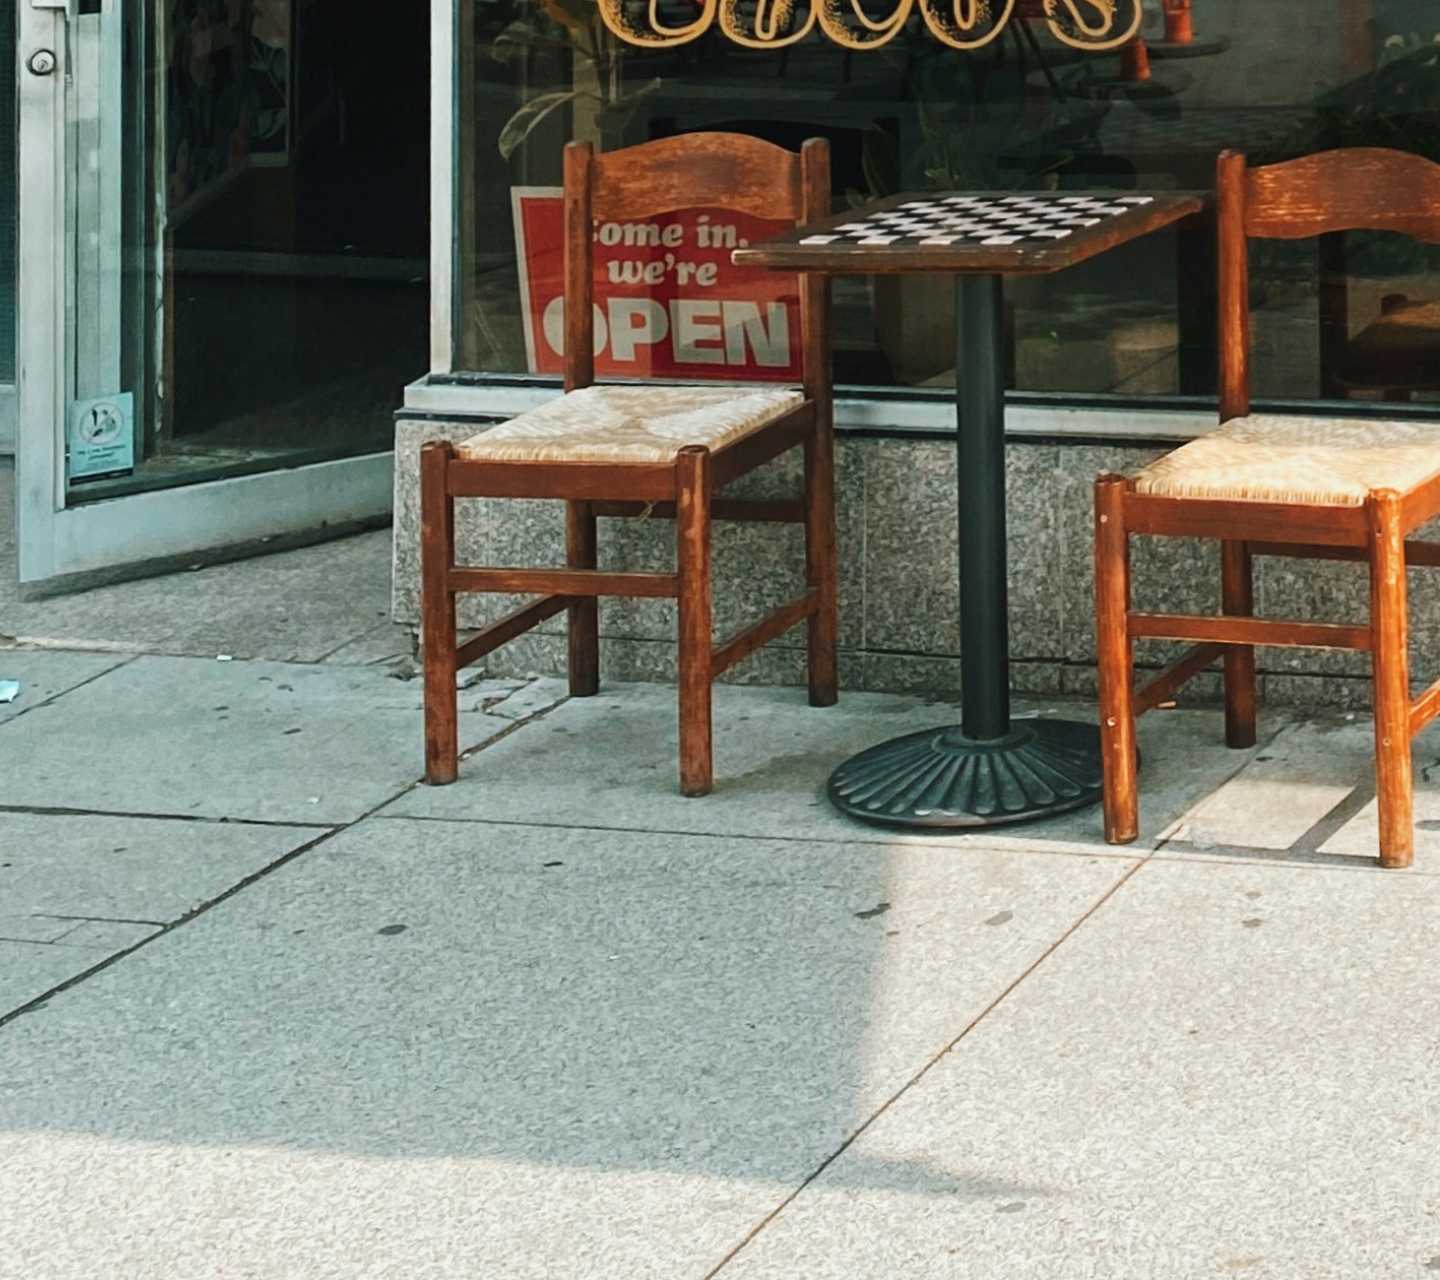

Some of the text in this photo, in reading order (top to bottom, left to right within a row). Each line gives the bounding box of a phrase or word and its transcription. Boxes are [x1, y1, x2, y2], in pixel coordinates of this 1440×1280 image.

[593, 220, 683, 247] ome
[607, 253, 717, 286] we're
[543, 296, 791, 367] OPEN
